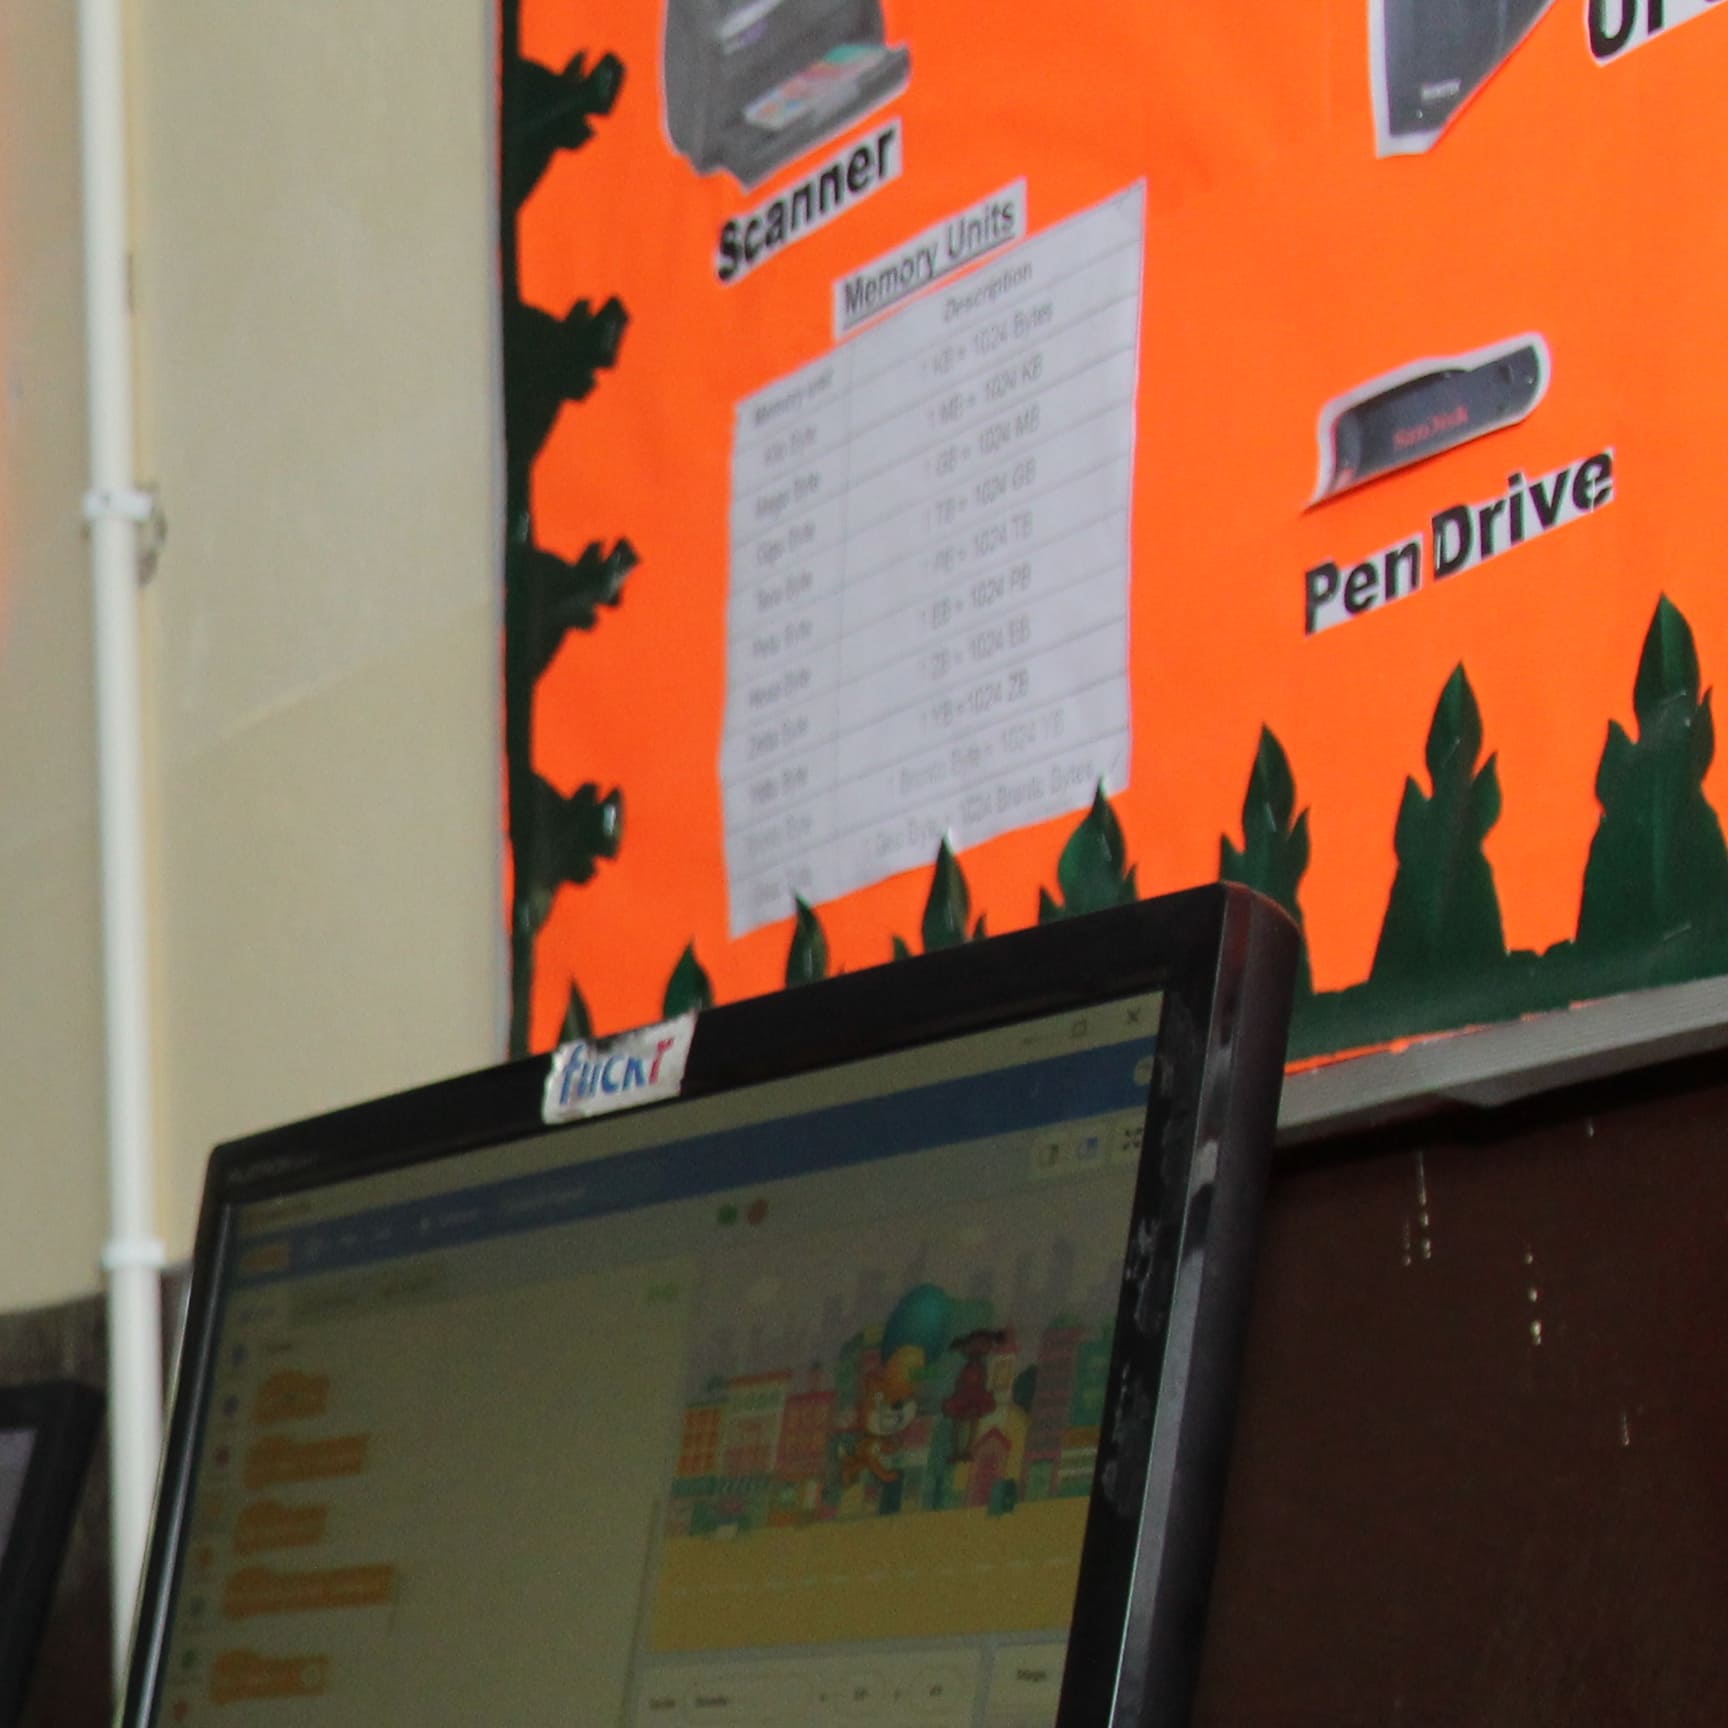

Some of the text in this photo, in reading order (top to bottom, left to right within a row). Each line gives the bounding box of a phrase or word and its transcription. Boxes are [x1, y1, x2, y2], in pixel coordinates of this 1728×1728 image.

[718, 129, 894, 281] Scanner
[845, 201, 1015, 314] Memory Units
[943, 254, 1032, 327] Description
[974, 316, 1008, 358] 1024
[1305, 451, 1612, 635] Pen Drive
